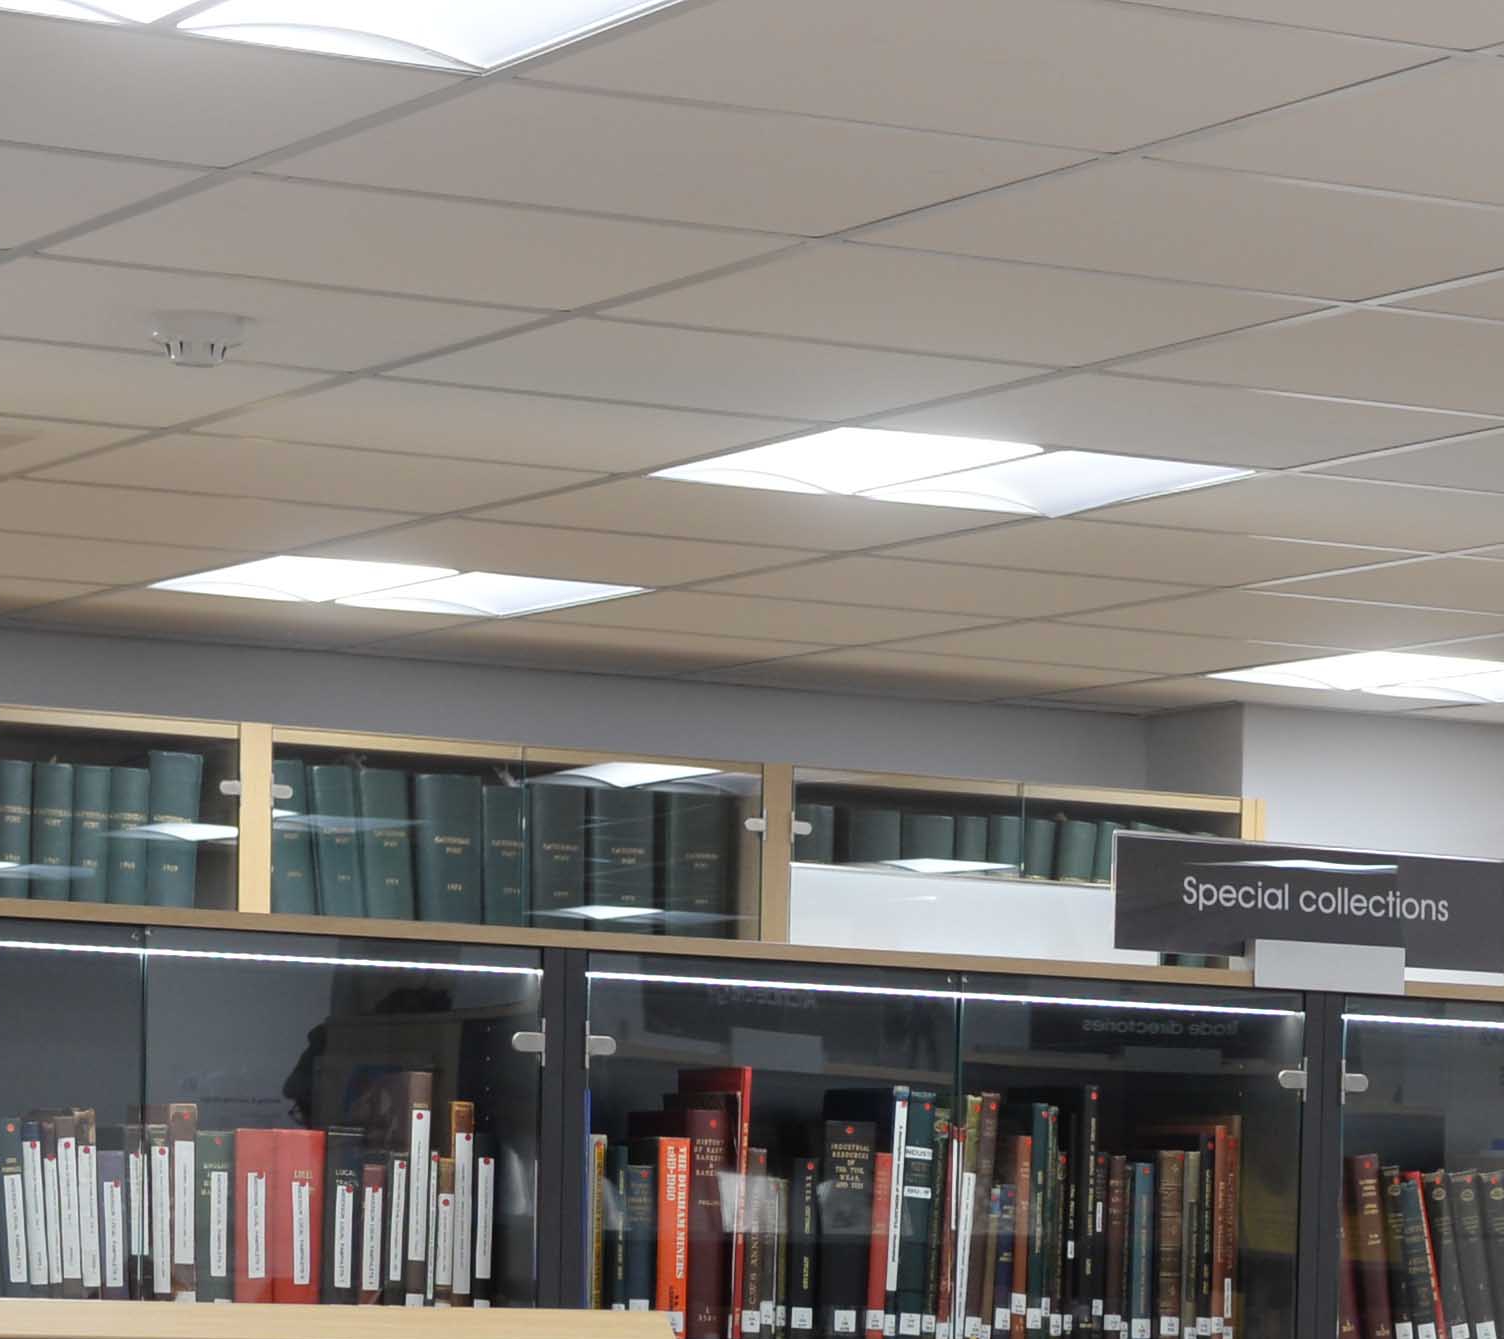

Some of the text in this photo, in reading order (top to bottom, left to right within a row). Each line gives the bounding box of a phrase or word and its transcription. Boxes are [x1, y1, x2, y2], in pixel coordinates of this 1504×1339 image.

[1182, 876, 1449, 922] Special collections
[676, 1146, 687, 1280] THE DURHAM MINERS
